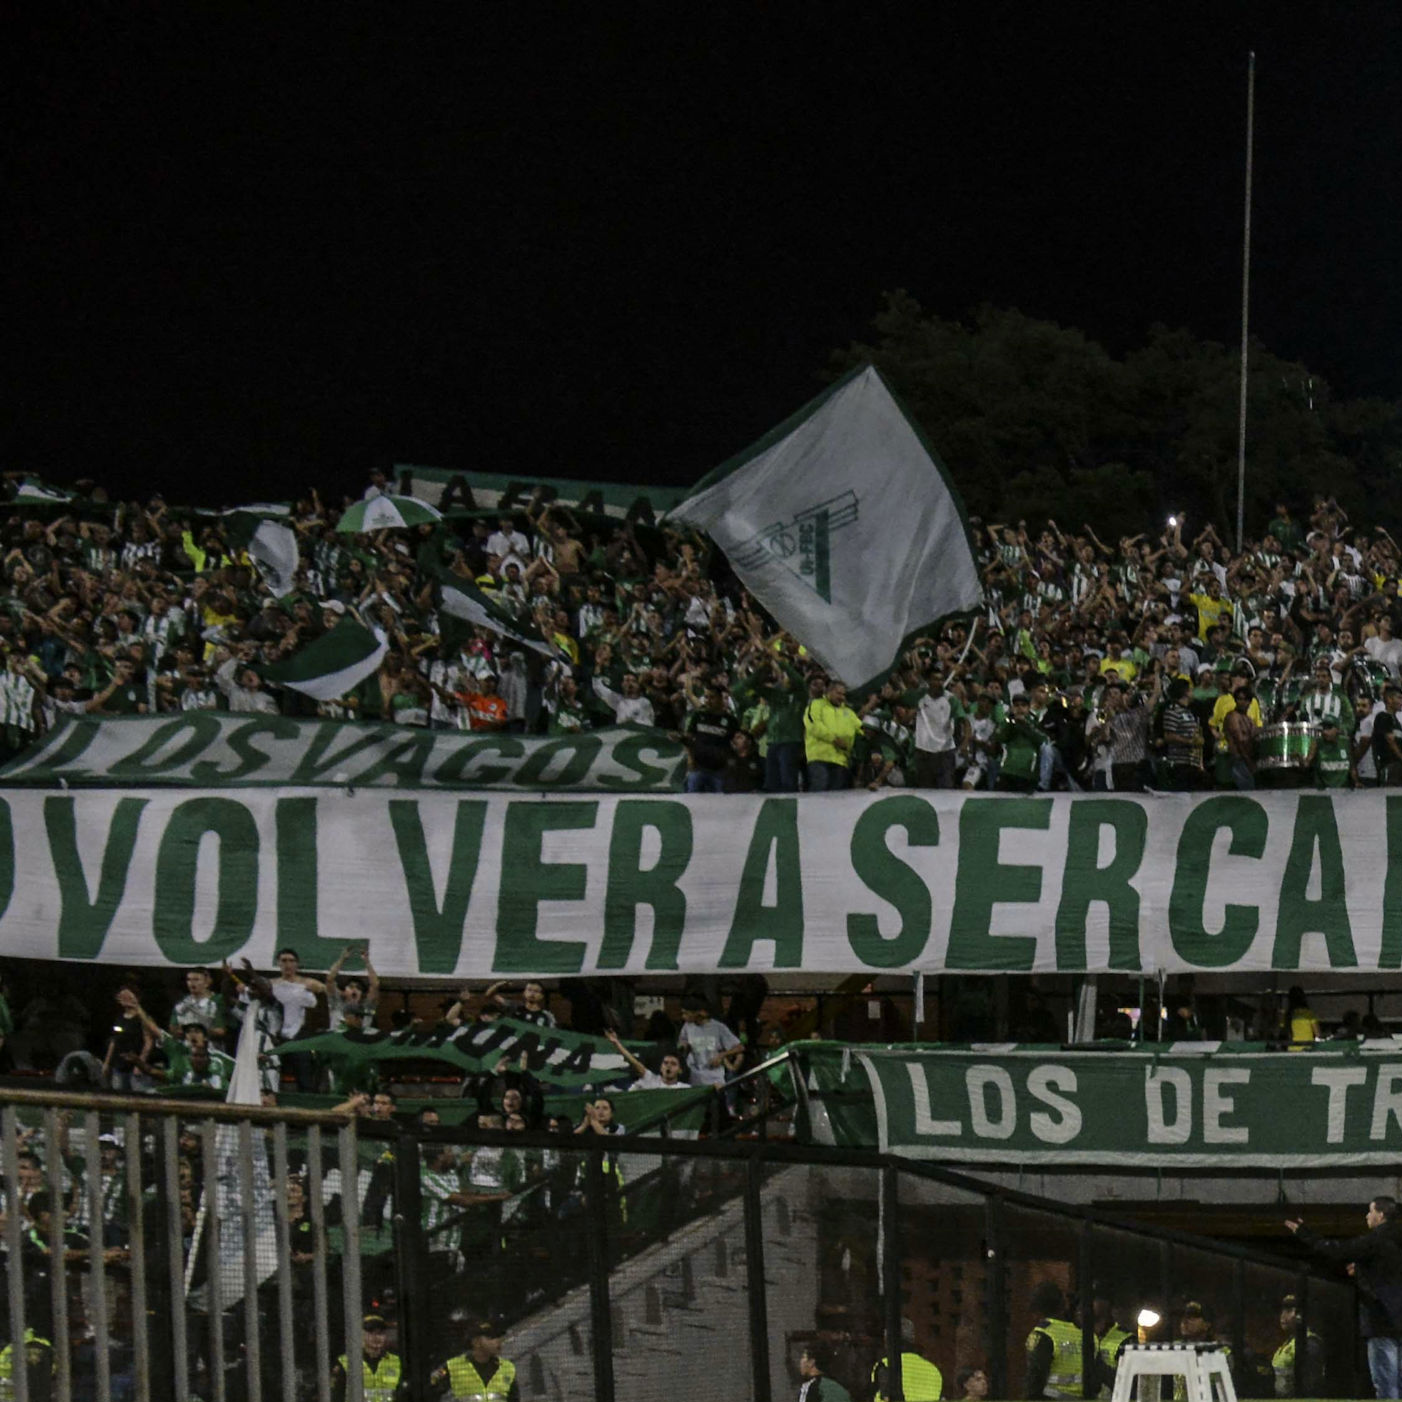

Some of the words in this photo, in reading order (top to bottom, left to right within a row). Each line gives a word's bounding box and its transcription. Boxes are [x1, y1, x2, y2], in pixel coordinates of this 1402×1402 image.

[34, 715, 295, 782] LOS
[287, 720, 684, 788] VAGOS
[846, 795, 1150, 970] SER
[905, 1061, 1083, 1144] LOS
[1146, 1062, 1250, 1145] DE
